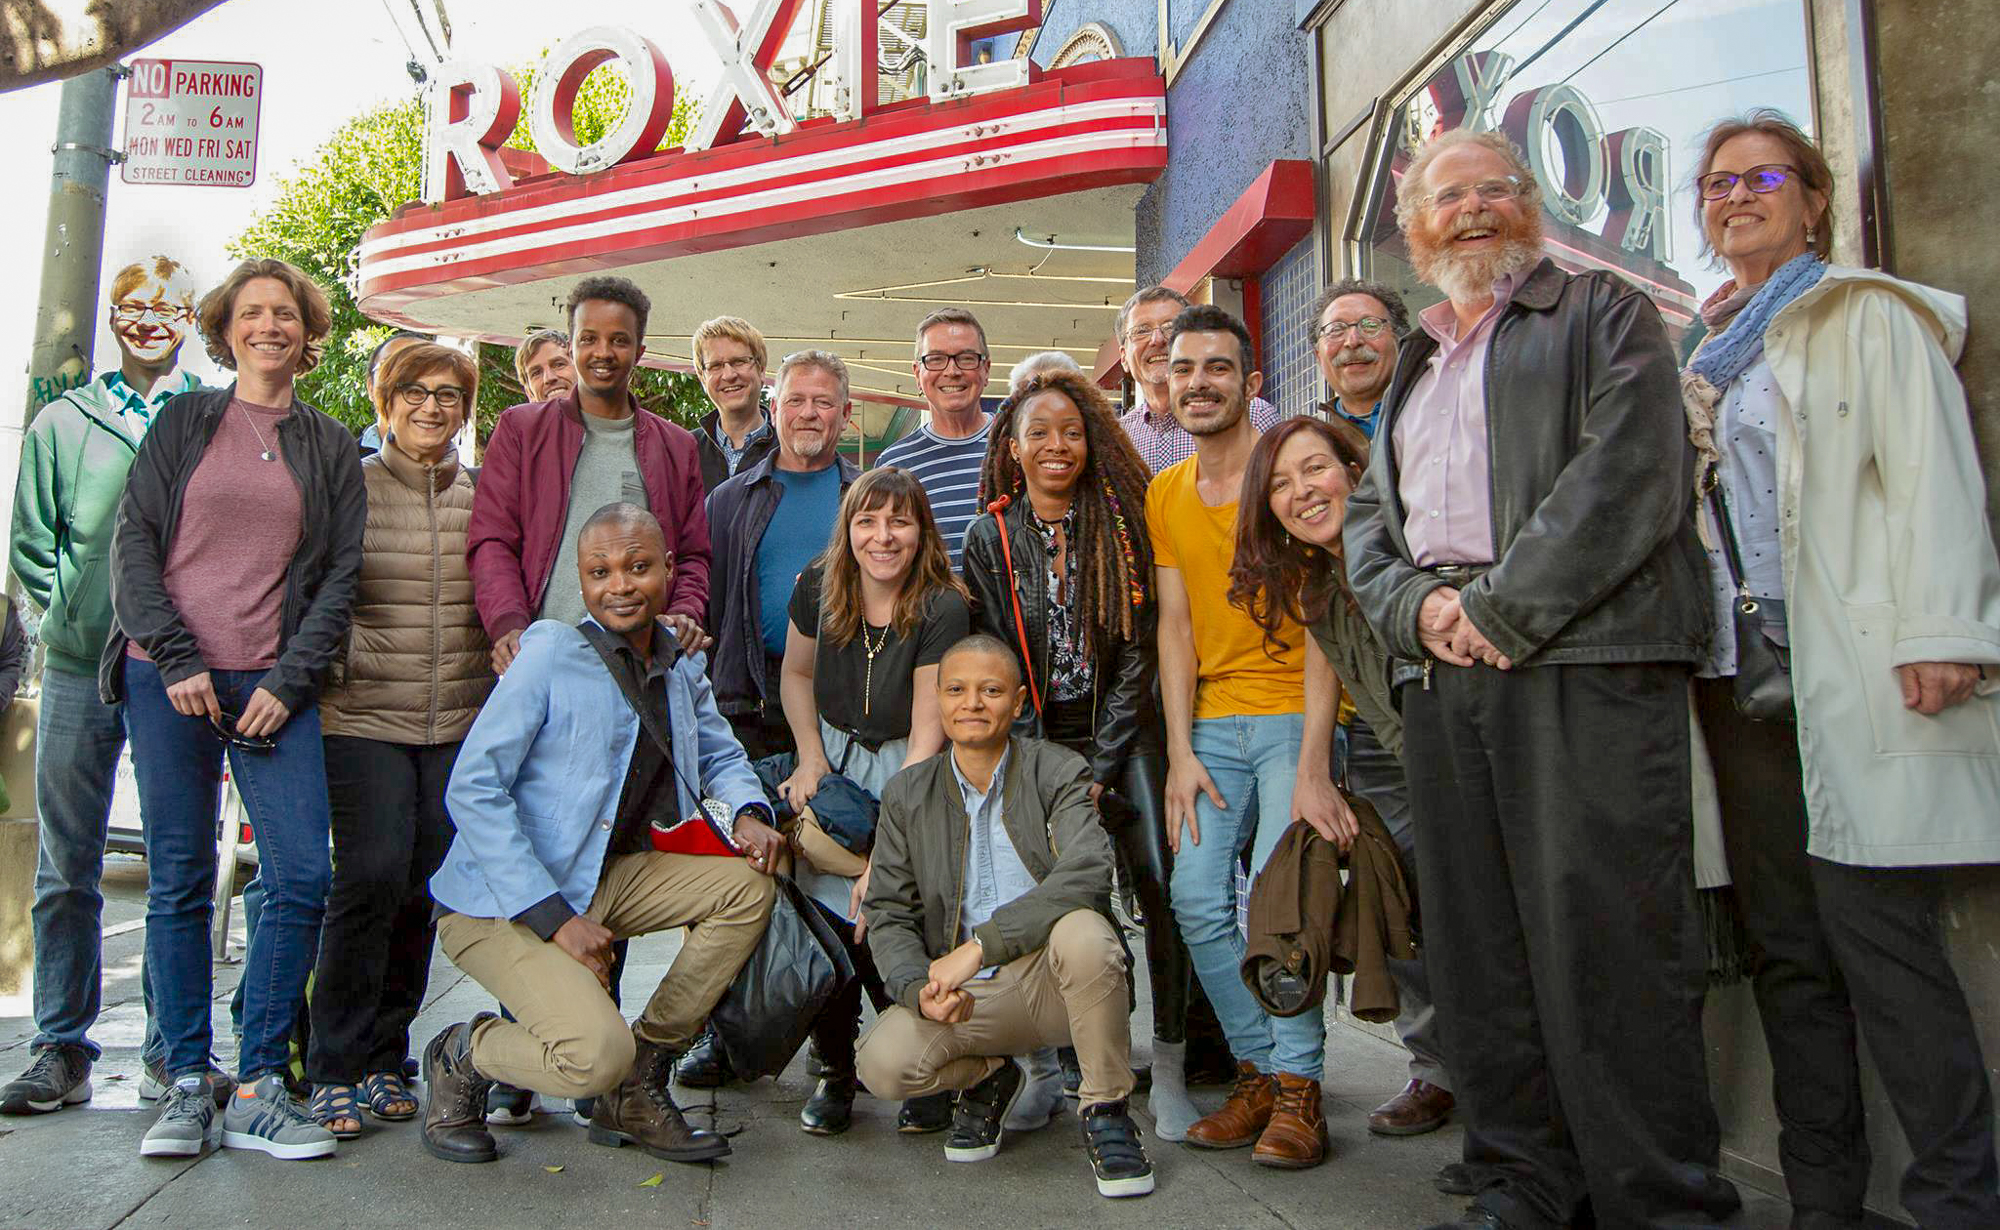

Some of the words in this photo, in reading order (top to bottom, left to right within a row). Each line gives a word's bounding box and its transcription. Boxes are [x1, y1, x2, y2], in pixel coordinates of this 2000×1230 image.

[132, 63, 166, 95] NO
[175, 71, 255, 97] PARKING
[419, 0, 1041, 204] ROXIE
[187, 117, 198, 128] TO
[129, 136, 159, 156] MON
[164, 137, 192, 157] WED
[198, 139, 220, 158] FRI
[225, 139, 252, 159] SAT
[132, 166, 178, 180] STREET
[184, 169, 244, 183] CLEANING
